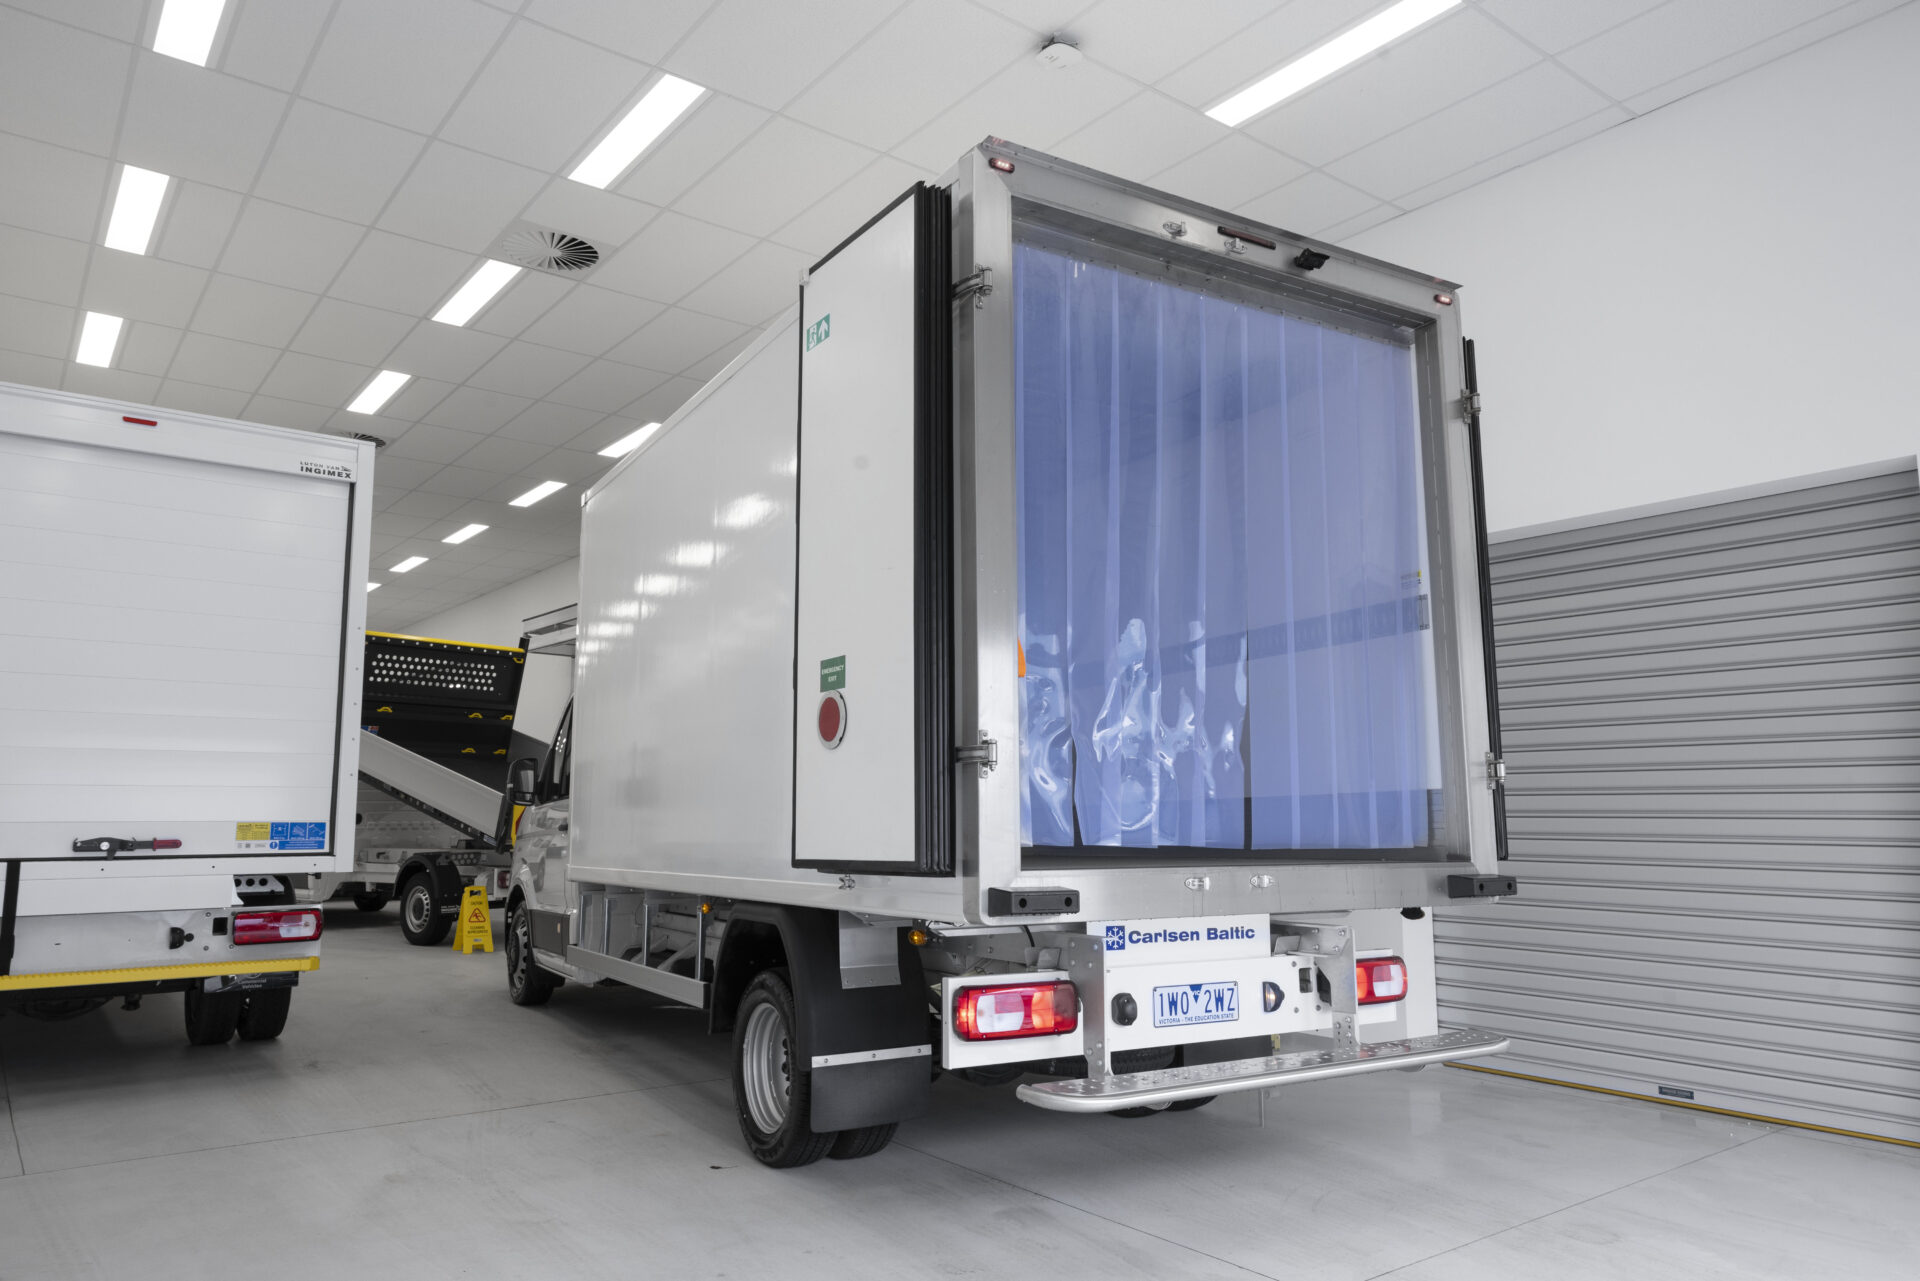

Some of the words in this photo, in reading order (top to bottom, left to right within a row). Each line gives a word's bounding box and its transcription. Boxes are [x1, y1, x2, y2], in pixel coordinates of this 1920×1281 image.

[300, 466, 352, 479] INGIMEX
[1128, 929, 1200, 944] Carlsen
[1206, 926, 1255, 941] Baltic
[1204, 988, 1235, 1013] 2WZ
[1194, 1014, 1219, 1022] EDUCATION
